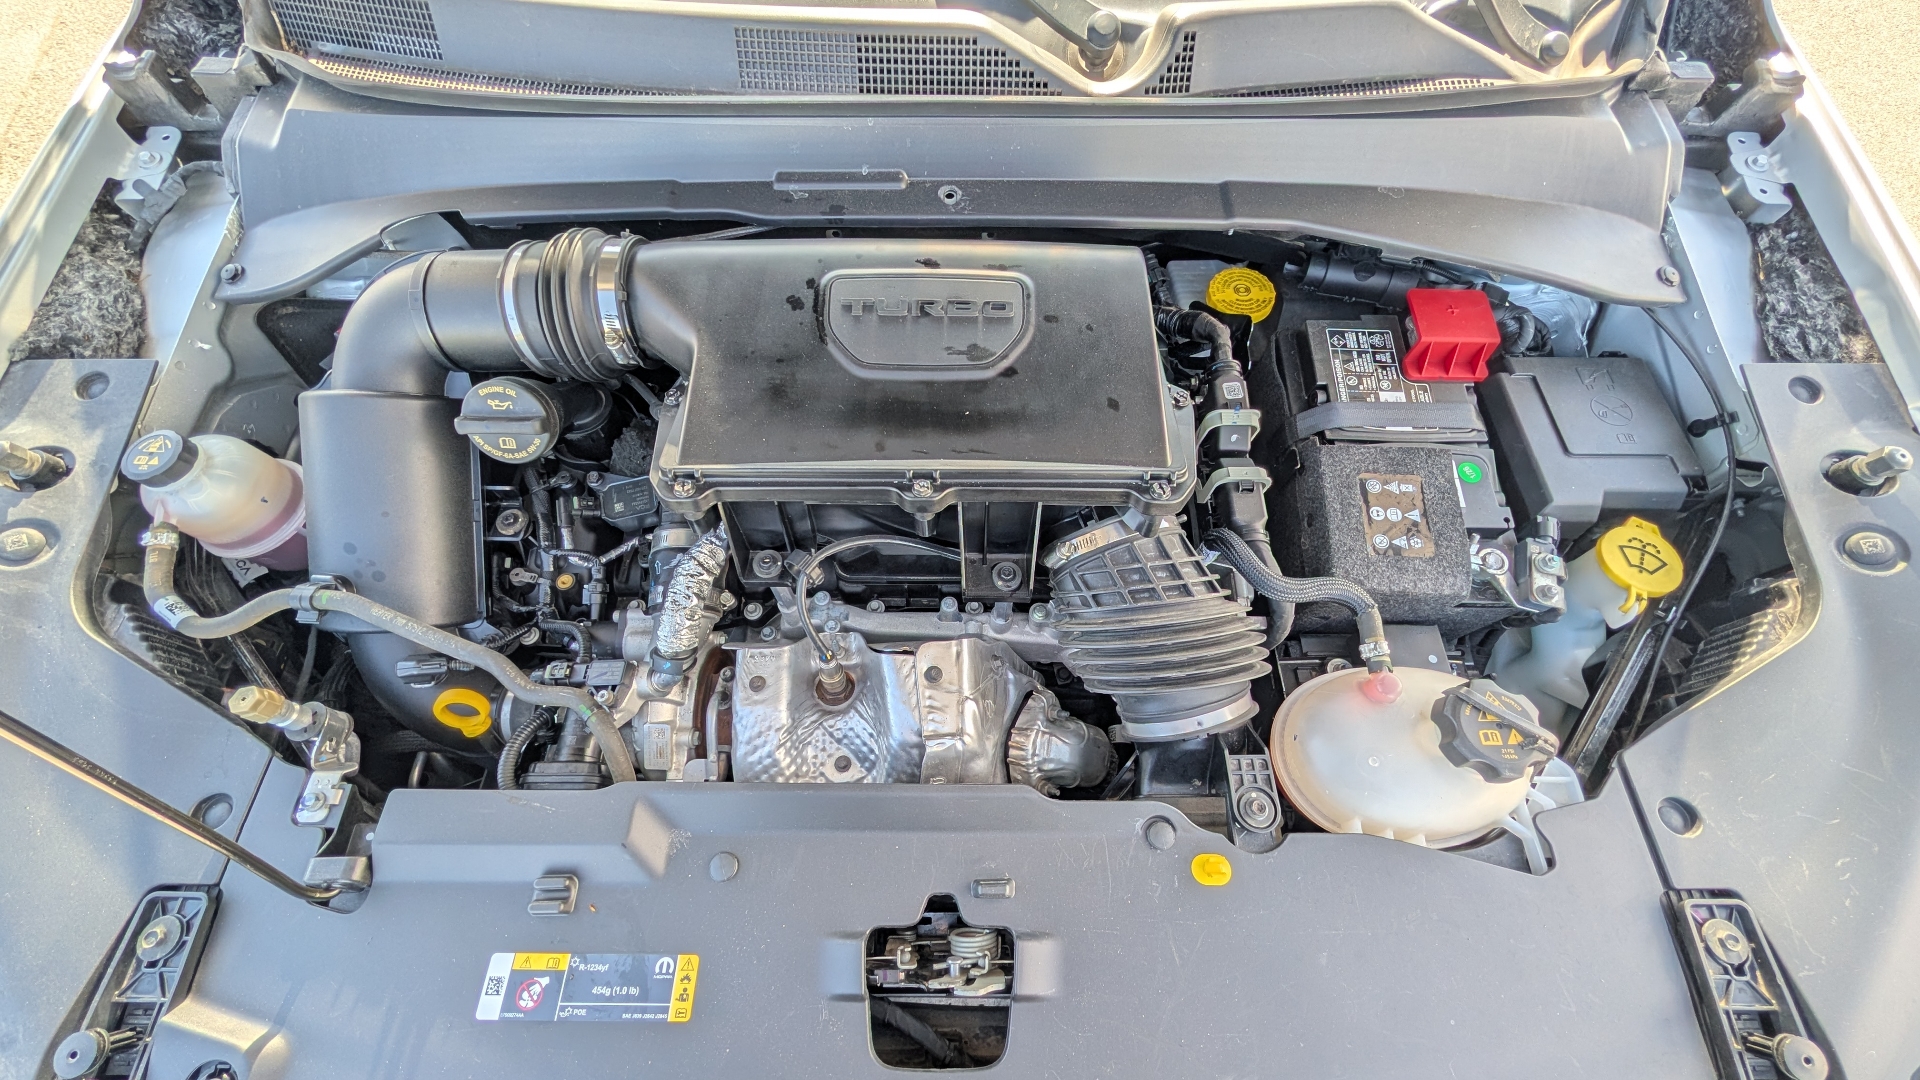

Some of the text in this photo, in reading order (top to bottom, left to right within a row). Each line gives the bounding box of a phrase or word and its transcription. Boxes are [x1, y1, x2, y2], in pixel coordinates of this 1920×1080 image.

[841, 298, 1015, 318] TURBO
[478, 386, 517, 398] ENGINE OIL
[472, 435, 484, 446] API
[578, 963, 609, 973] R-1234yf
[591, 986, 639, 996] 454g (1.0 lb)
